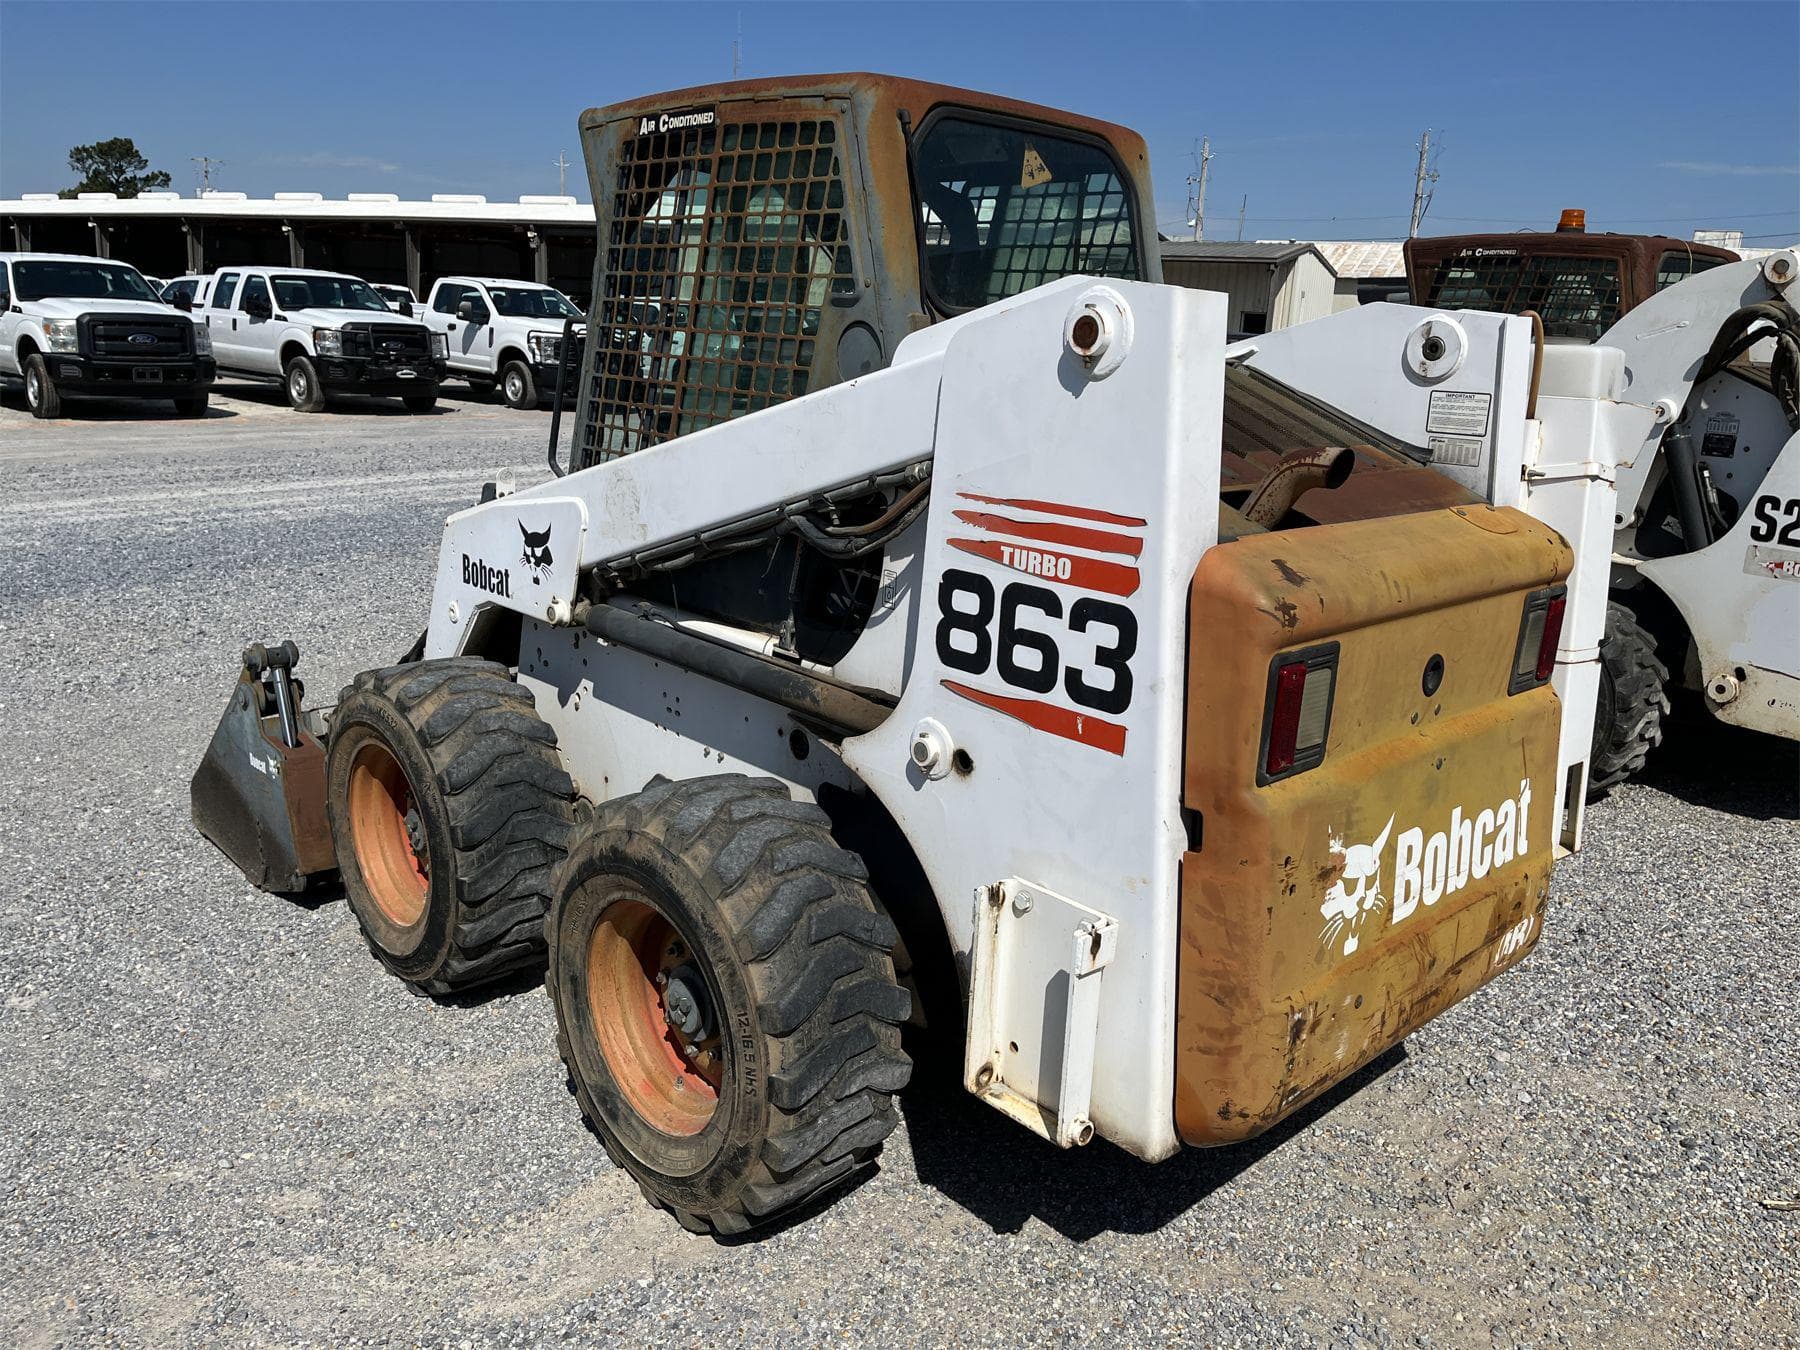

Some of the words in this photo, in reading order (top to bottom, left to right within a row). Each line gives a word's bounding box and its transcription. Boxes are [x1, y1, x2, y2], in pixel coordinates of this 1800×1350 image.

[640, 117, 656, 135] AIR
[659, 112, 714, 133] CONDITIONED
[462, 553, 510, 599] Bobcat
[1001, 545, 1072, 580] TURBO
[935, 568, 1139, 715] 863
[1392, 777, 1532, 925] Bobcat
[736, 1011, 756, 1063] 12-16.5
[744, 1066, 758, 1098] NHS
